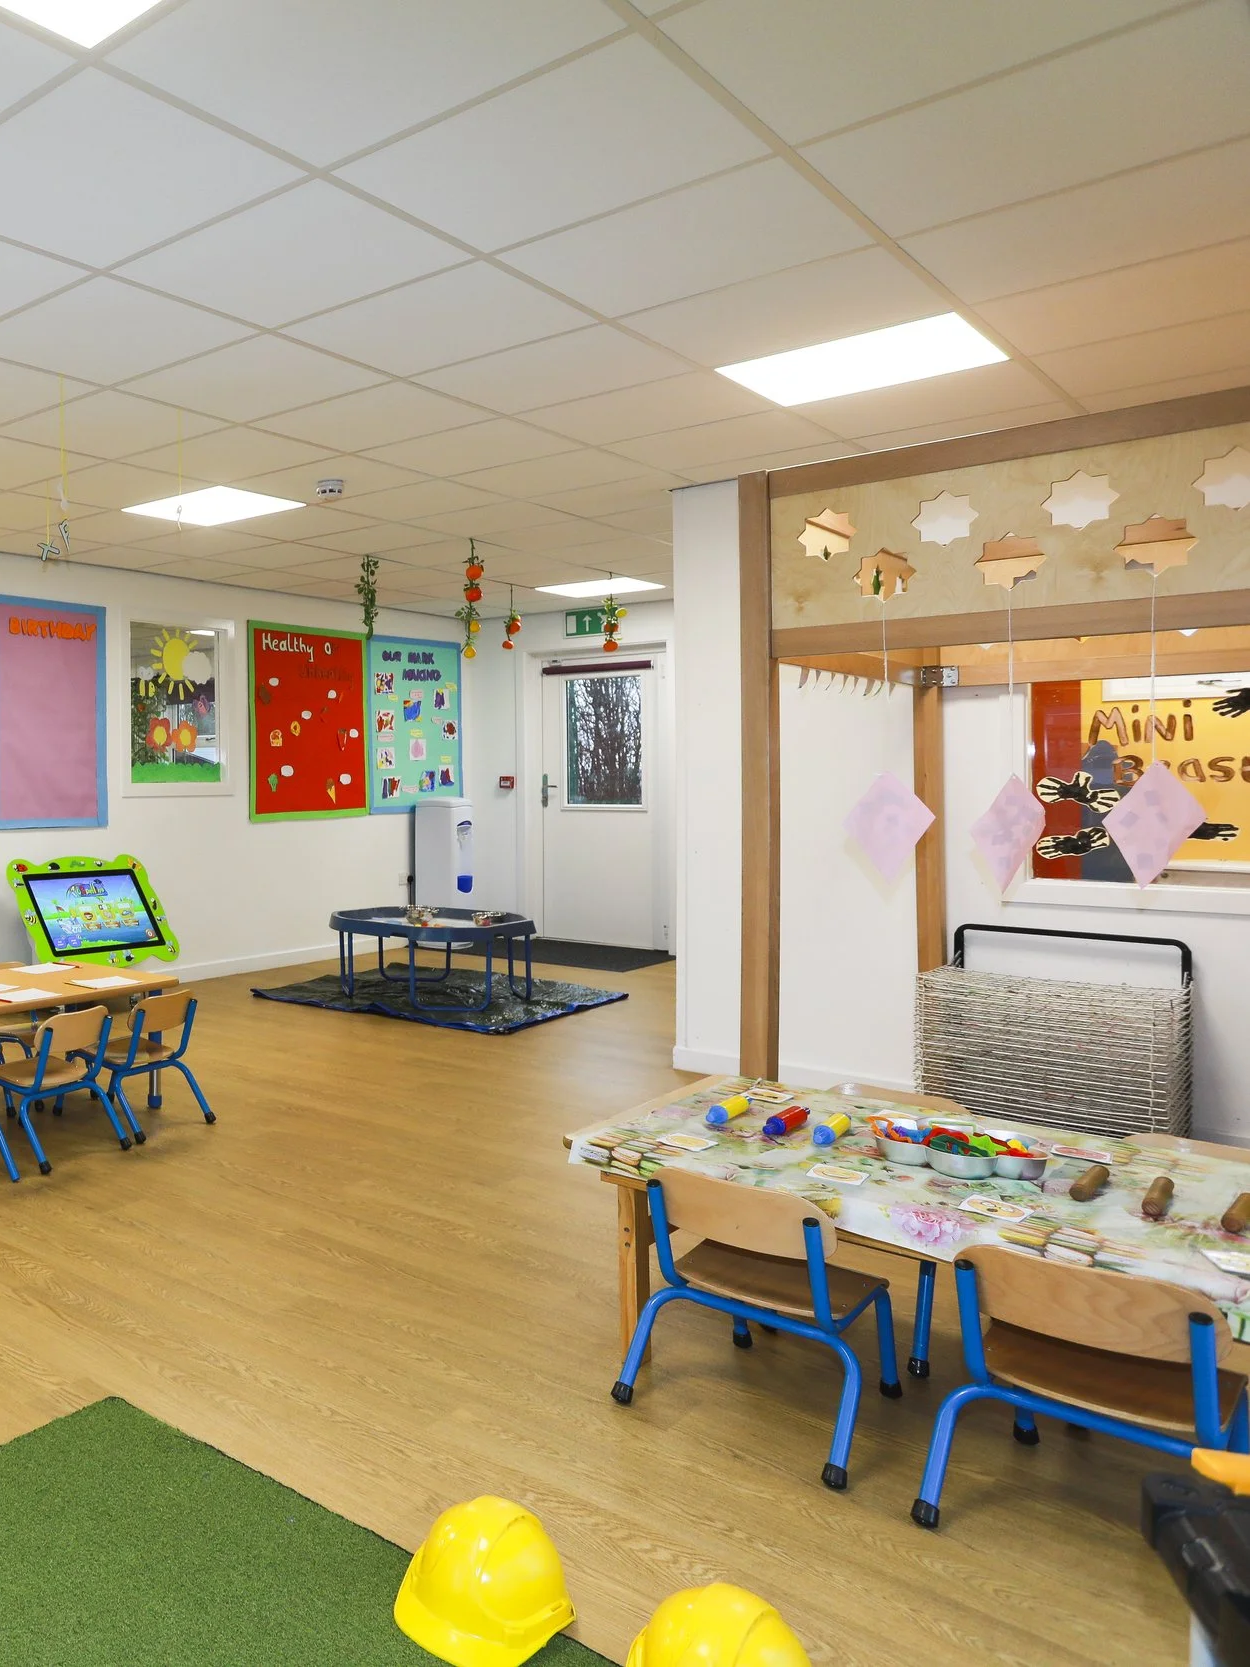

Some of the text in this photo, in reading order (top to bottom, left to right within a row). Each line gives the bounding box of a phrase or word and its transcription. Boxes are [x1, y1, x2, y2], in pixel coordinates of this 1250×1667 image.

[9, 616, 97, 641] BIRTHDAY
[262, 632, 314, 662] Healthy
[382, 650, 434, 664] OUR MARK
